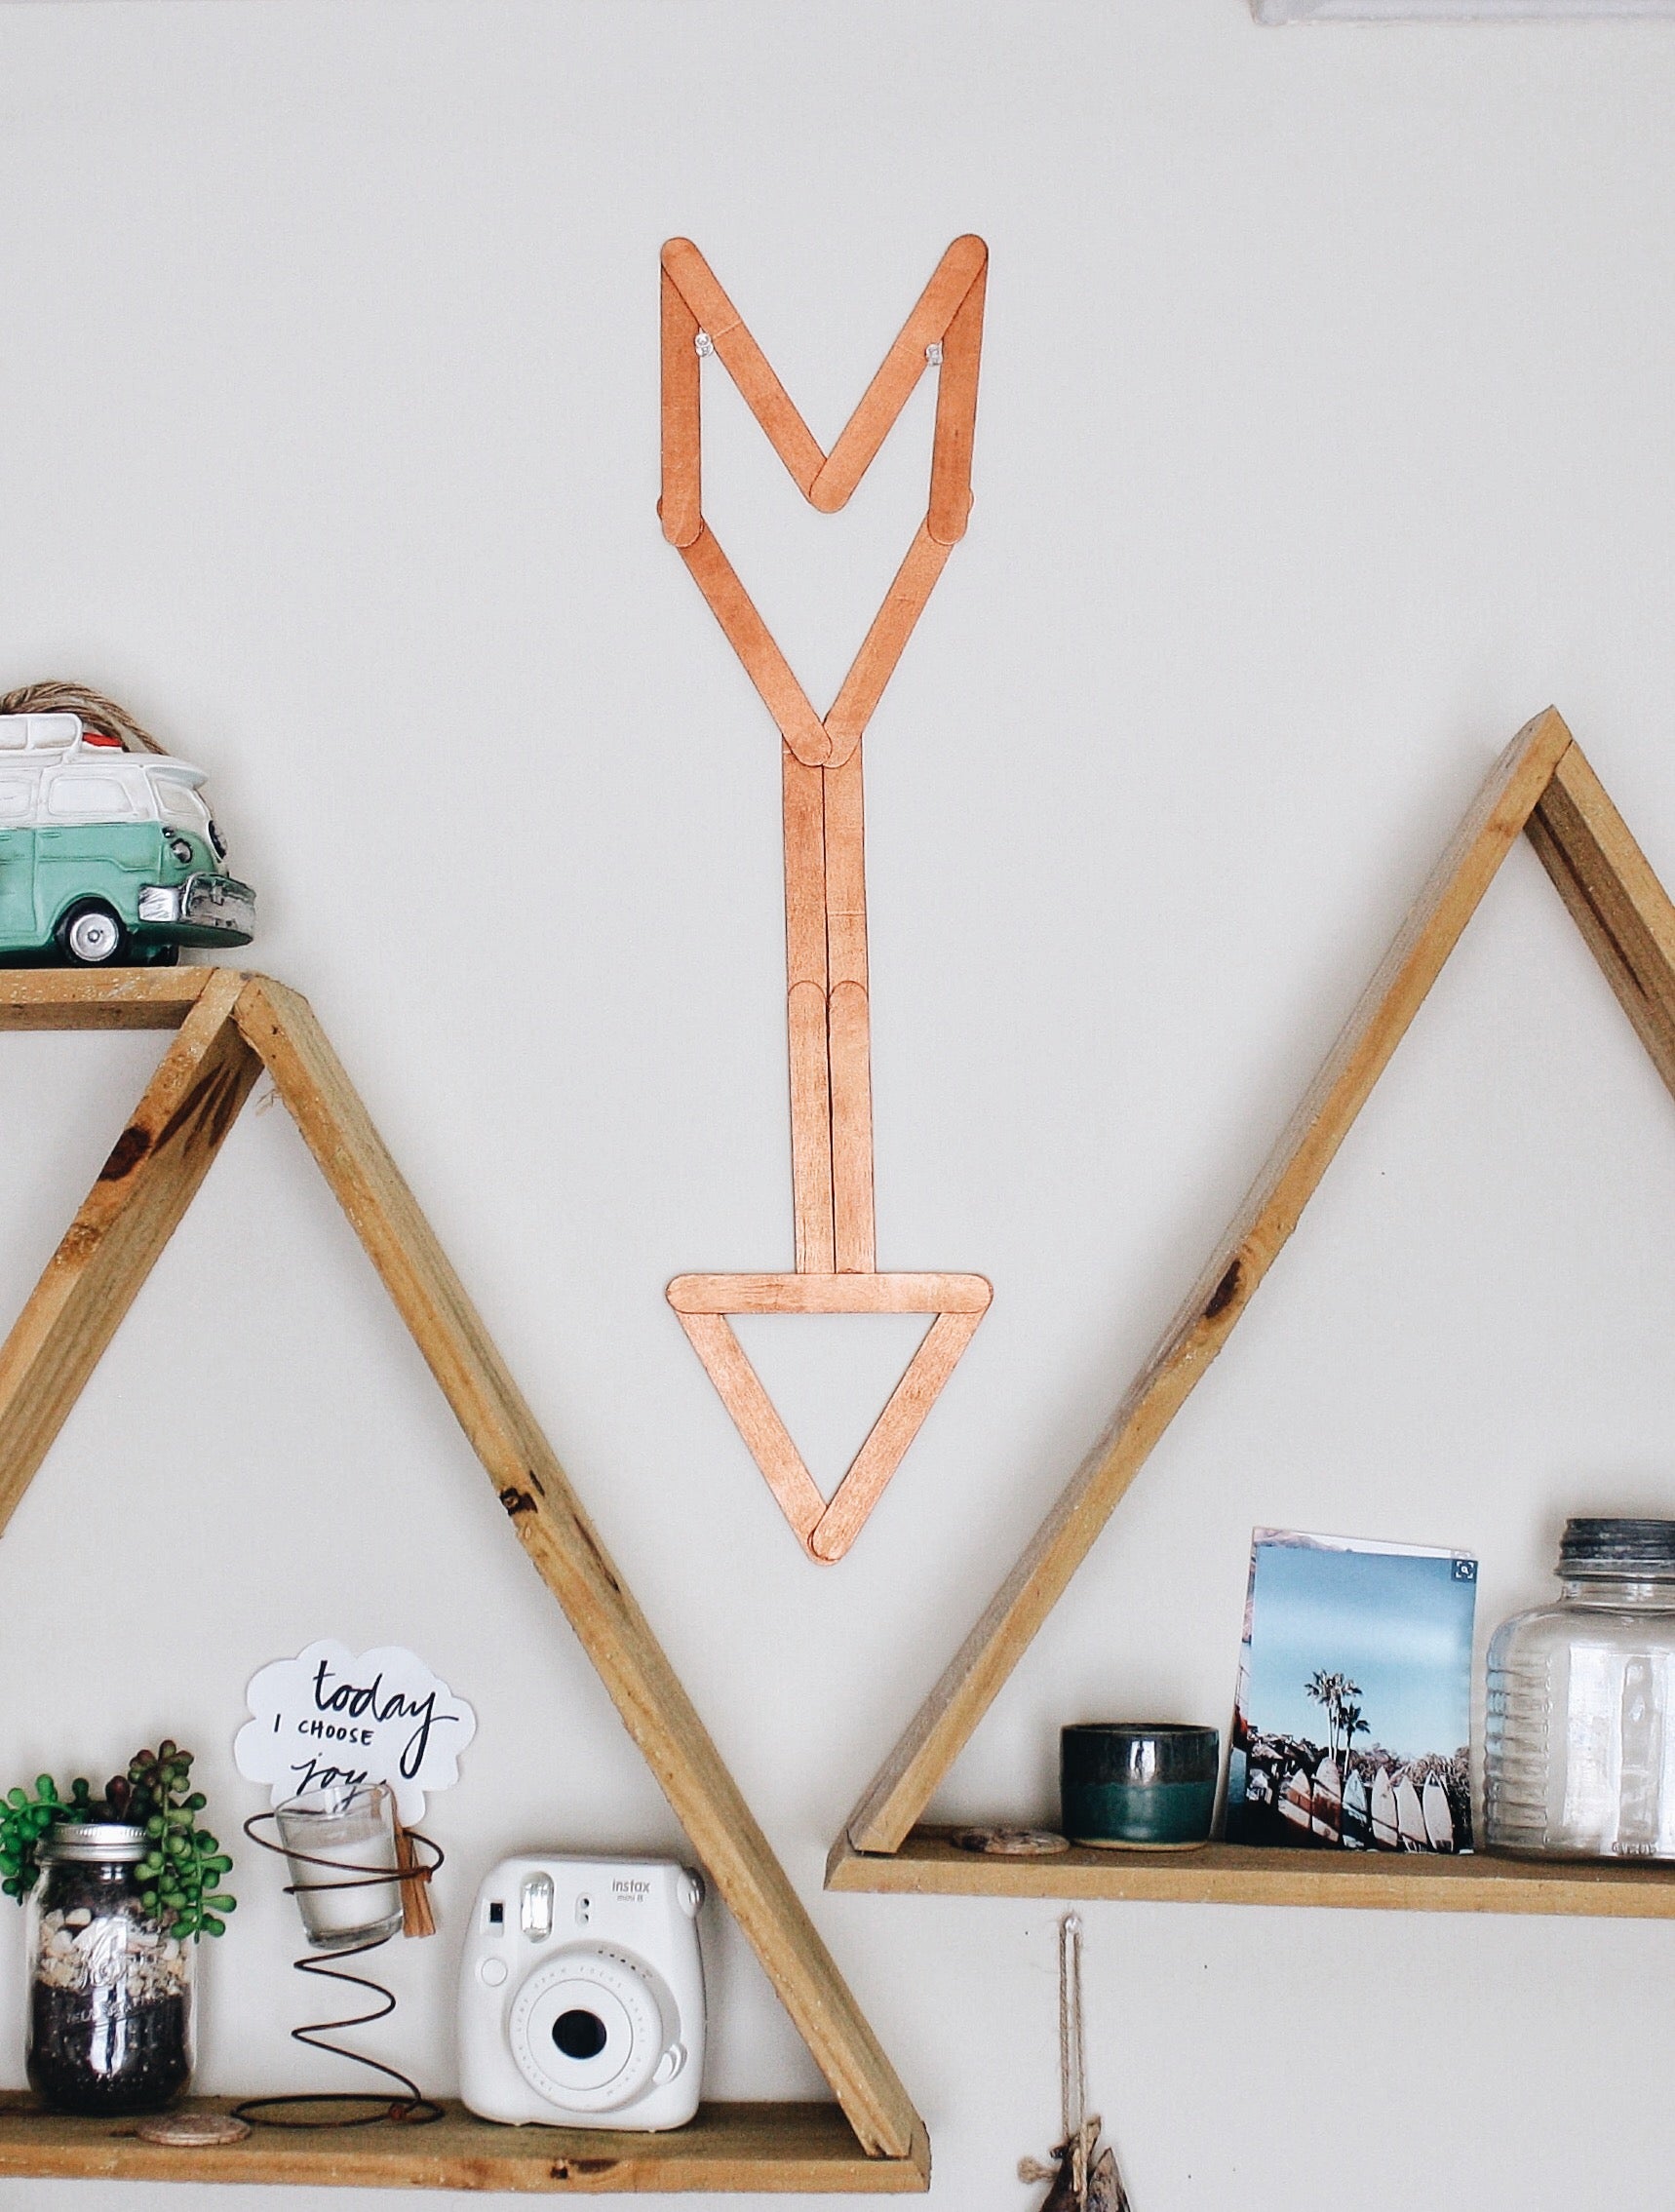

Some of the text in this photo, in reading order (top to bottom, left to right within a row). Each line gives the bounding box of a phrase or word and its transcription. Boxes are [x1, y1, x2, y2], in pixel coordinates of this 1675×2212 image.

[274, 1714, 374, 1745] I CHOOSE
[313, 1660, 459, 1779] today
[291, 1752, 387, 1813] joy
[612, 1878, 650, 1893] instax
